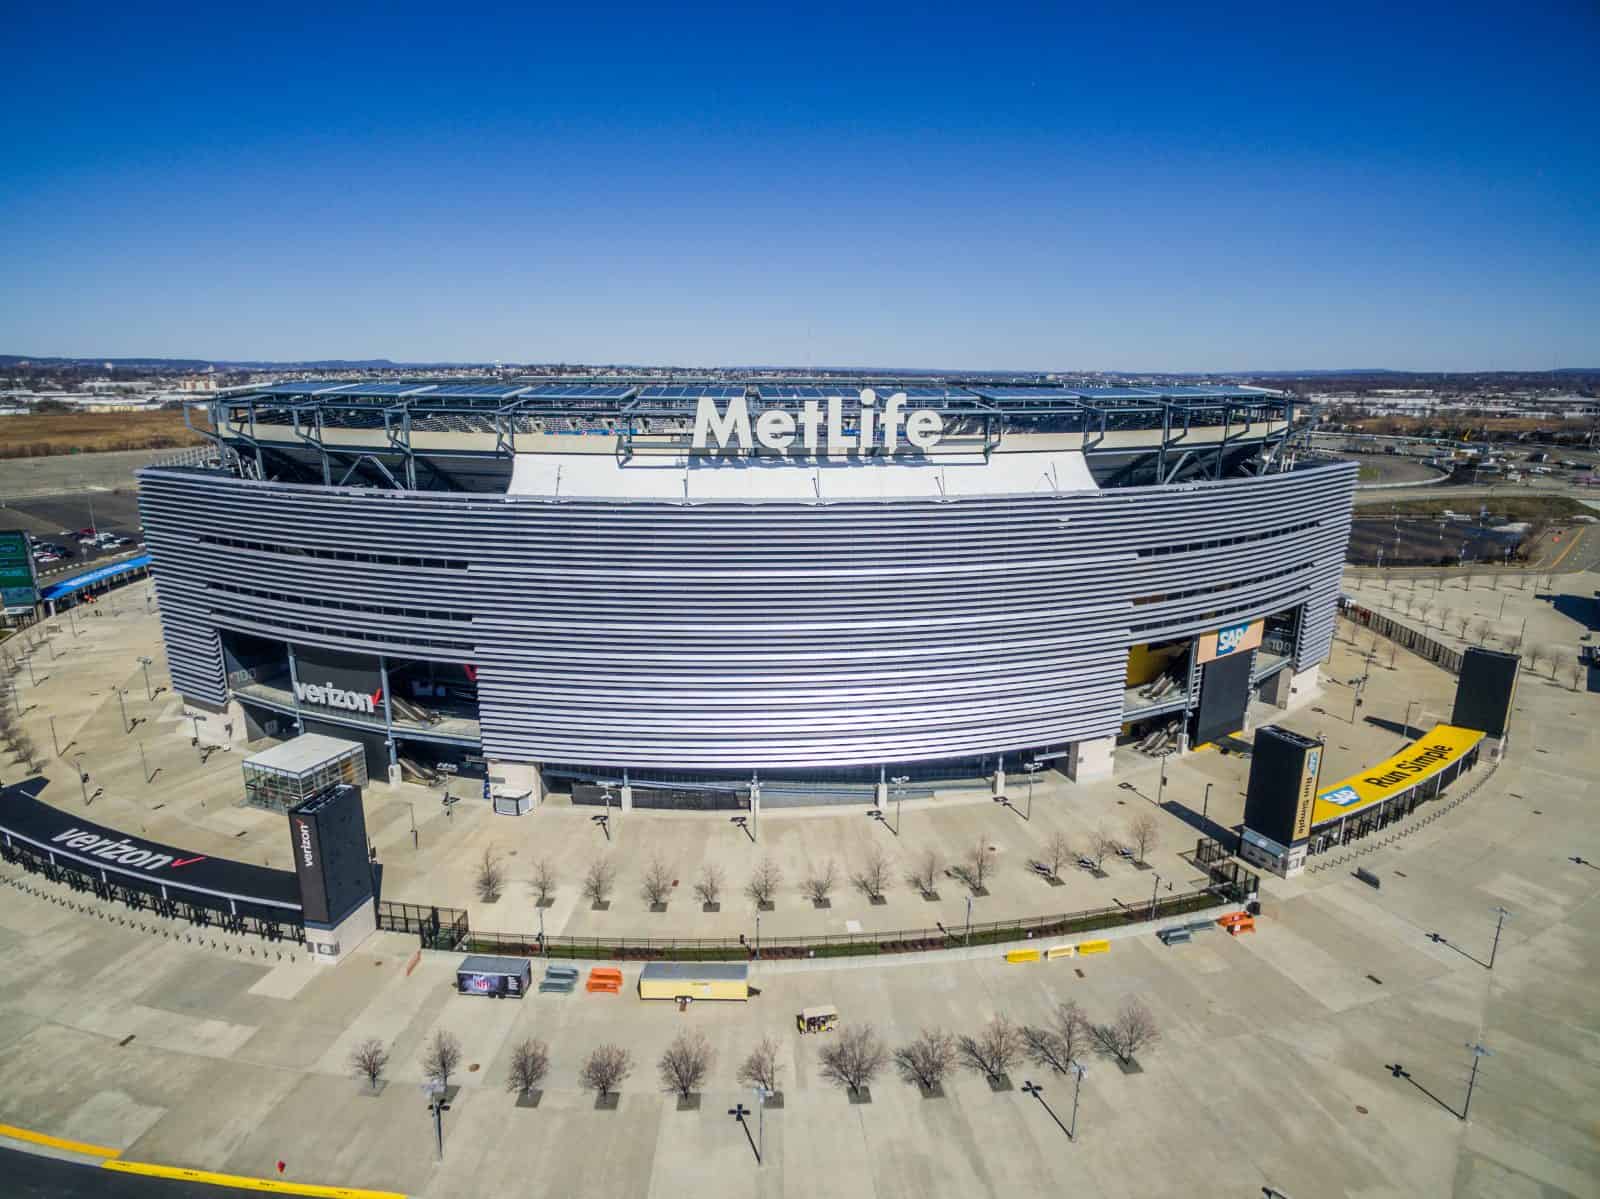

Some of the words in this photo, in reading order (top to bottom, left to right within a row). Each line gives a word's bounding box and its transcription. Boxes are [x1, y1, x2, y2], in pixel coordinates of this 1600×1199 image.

[692, 388, 944, 449] MetLife
[1219, 628, 1245, 650] SAP
[294, 681, 374, 713] verizon
[1363, 770, 1411, 788] Run
[1396, 744, 1453, 773] Simple
[1323, 788, 1358, 805] SAP
[51, 828, 174, 870] verizon
[300, 824, 313, 868] verizon
